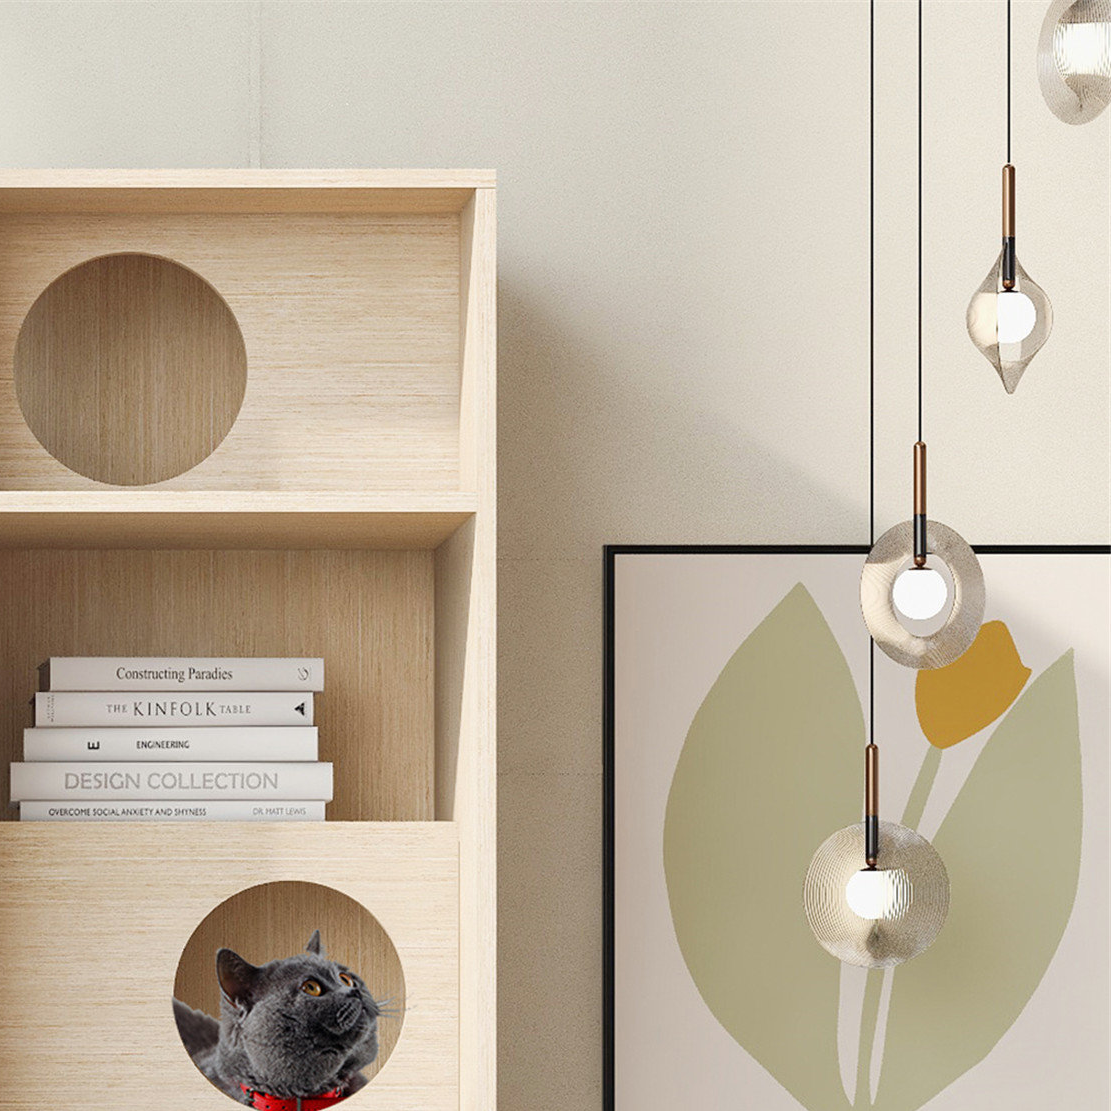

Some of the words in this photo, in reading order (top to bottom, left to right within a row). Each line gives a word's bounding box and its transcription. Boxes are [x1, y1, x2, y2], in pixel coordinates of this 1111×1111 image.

[116, 666, 186, 684] Constructing
[188, 667, 233, 681] Paradies
[106, 704, 128, 714] THE
[133, 701, 217, 717] KINFOLK
[220, 704, 251, 714] TABLE
[136, 740, 190, 749] ENGINEERING
[64, 772, 140, 790] DESIGN
[147, 772, 278, 790] COLLECTION
[48, 807, 91, 817] OVERCOME
[92, 807, 120, 817] SOCIAL
[121, 807, 154, 817] ANXIETY
[154, 807, 173, 817] AND
[174, 807, 207, 817] SHYNESS
